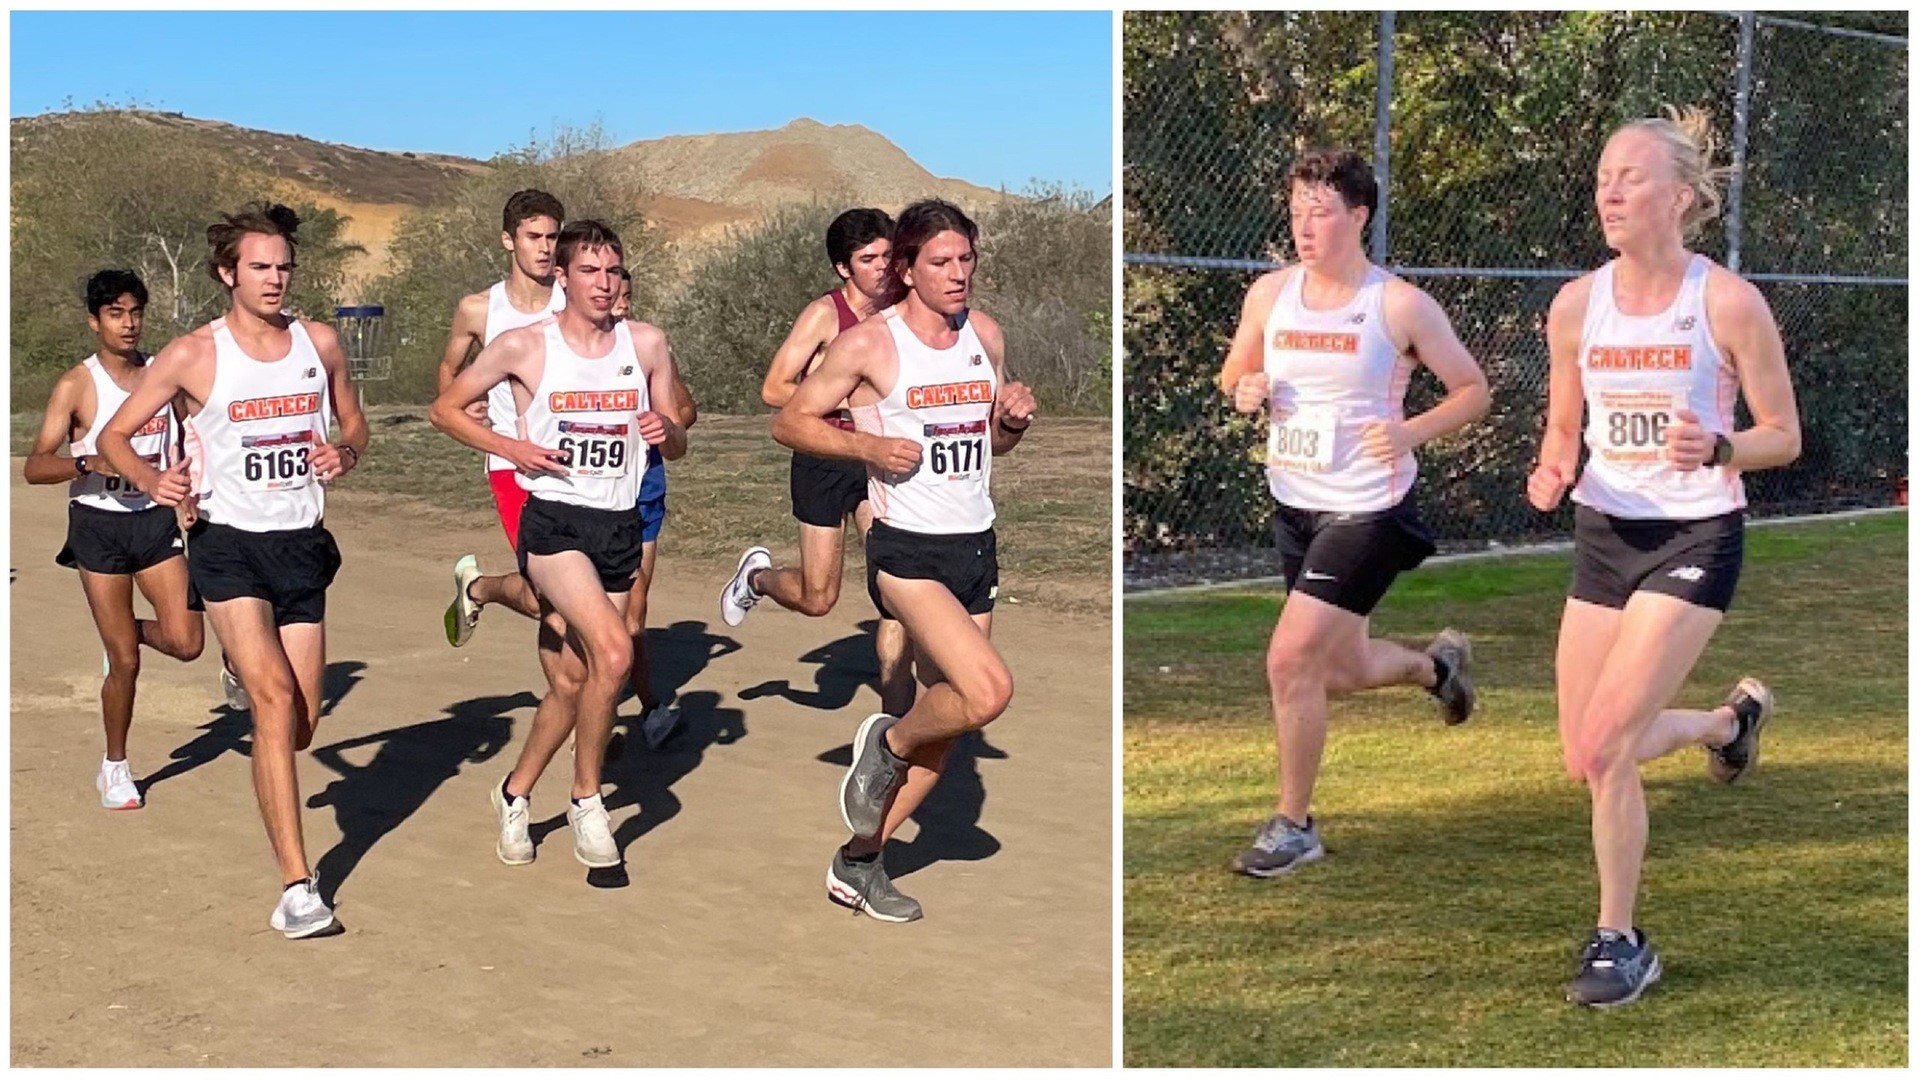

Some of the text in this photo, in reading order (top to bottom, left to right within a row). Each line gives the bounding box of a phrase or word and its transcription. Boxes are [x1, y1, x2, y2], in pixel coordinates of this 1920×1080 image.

[1587, 344, 1692, 371] CALTECH
[228, 392, 320, 422] CALTECH
[548, 389, 639, 413] CALTECH
[906, 380, 992, 410] CALTECH
[1277, 426, 1319, 458] 803
[1608, 411, 1670, 446] 806
[244, 447, 310, 481] 6163
[558, 437, 625, 469] 6159
[931, 439, 983, 474] 6171
